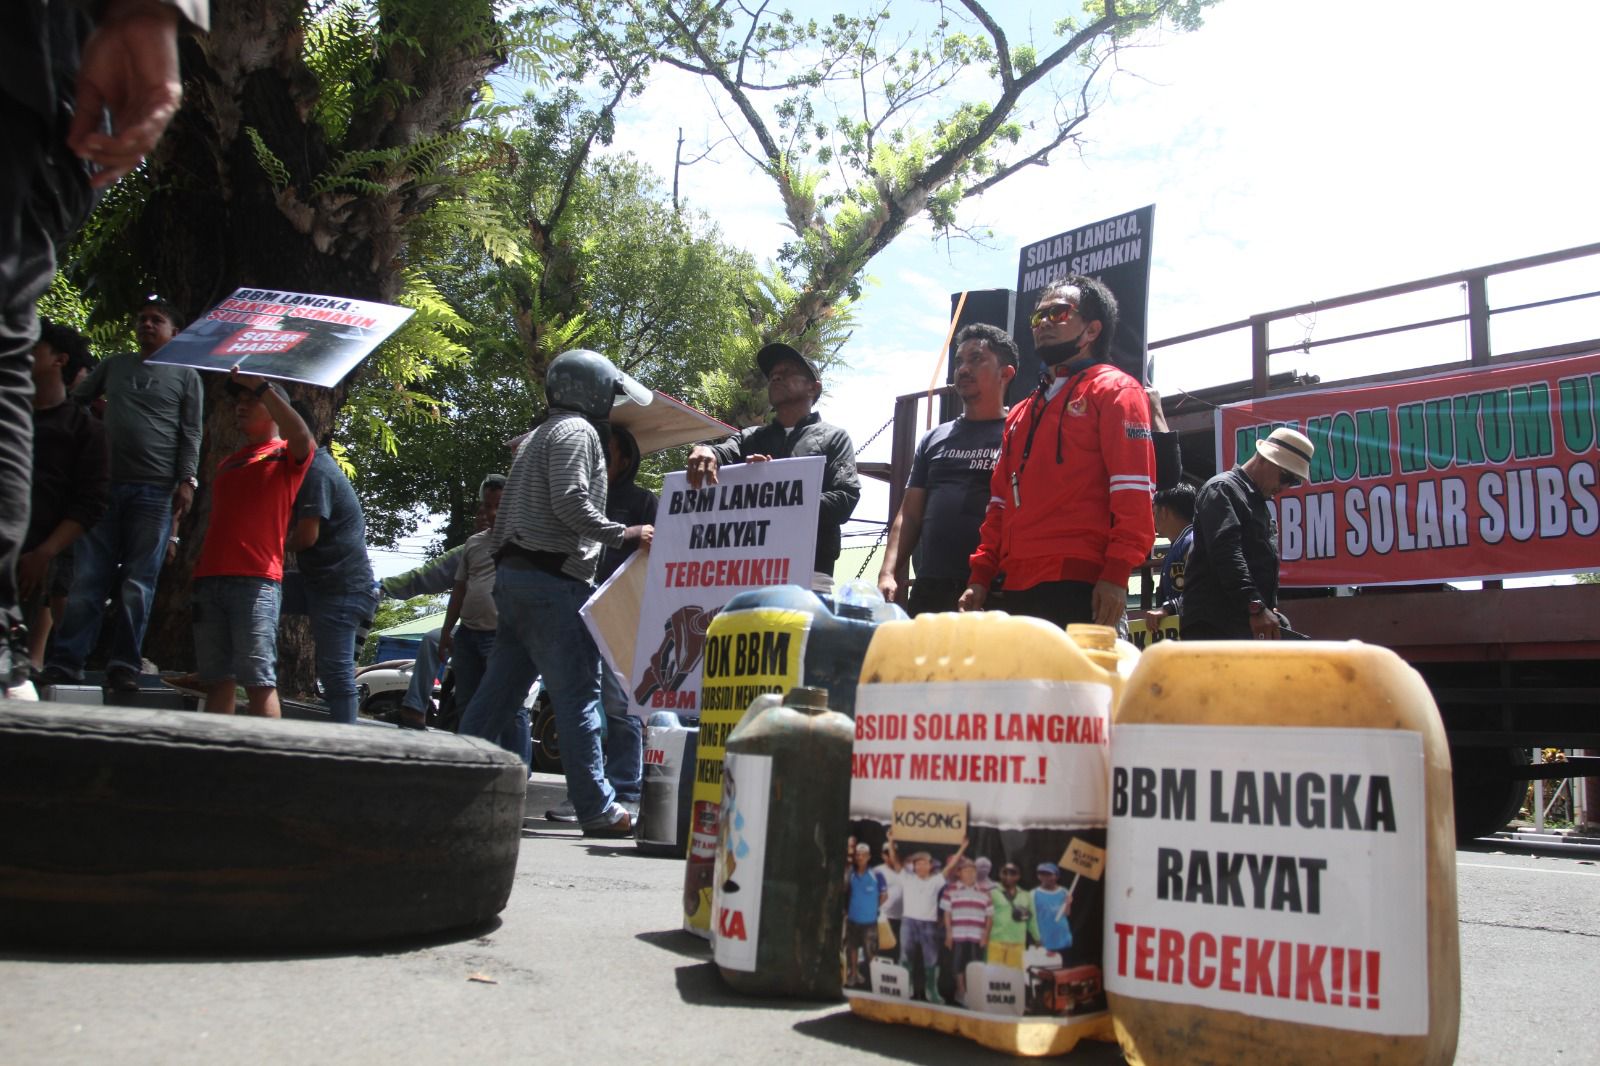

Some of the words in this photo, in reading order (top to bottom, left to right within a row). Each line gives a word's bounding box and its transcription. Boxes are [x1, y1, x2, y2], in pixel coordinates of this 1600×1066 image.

[1026, 235, 1073, 267] SOLAR
[1076, 215, 1141, 251] LANGKA,
[1023, 261, 1067, 292] MAFIA
[1071, 239, 1141, 276] SEMAKIN
[235, 290, 280, 301] BBM
[219, 300, 289, 315] RAKYAT
[290, 307, 376, 328] SEMAKIN
[226, 342, 288, 352] HABIS
[238, 331, 300, 342] SOLAR
[1397, 380, 1555, 474] HUKUM
[1557, 371, 1600, 455] U
[669, 486, 716, 515] BBM
[719, 479, 803, 511] LANGKA
[1344, 476, 1468, 557] SOLAR
[689, 520, 771, 549] RAKYAT
[664, 558, 790, 588] TERCEKIK!!!
[706, 634, 732, 678] OK
[735, 631, 791, 677] BBM
[651, 690, 696, 710] BBM
[700, 722, 719, 747] ONG
[913, 713, 987, 740] SOLAR
[851, 753, 905, 779] AKYAT
[1112, 767, 1197, 821] BBM
[1210, 769, 1397, 833] LANGKA
[895, 811, 962, 830] KOSONG
[1156, 847, 1327, 914] RAKYAT
[1114, 922, 1381, 1010] TERCEKIK!!!
